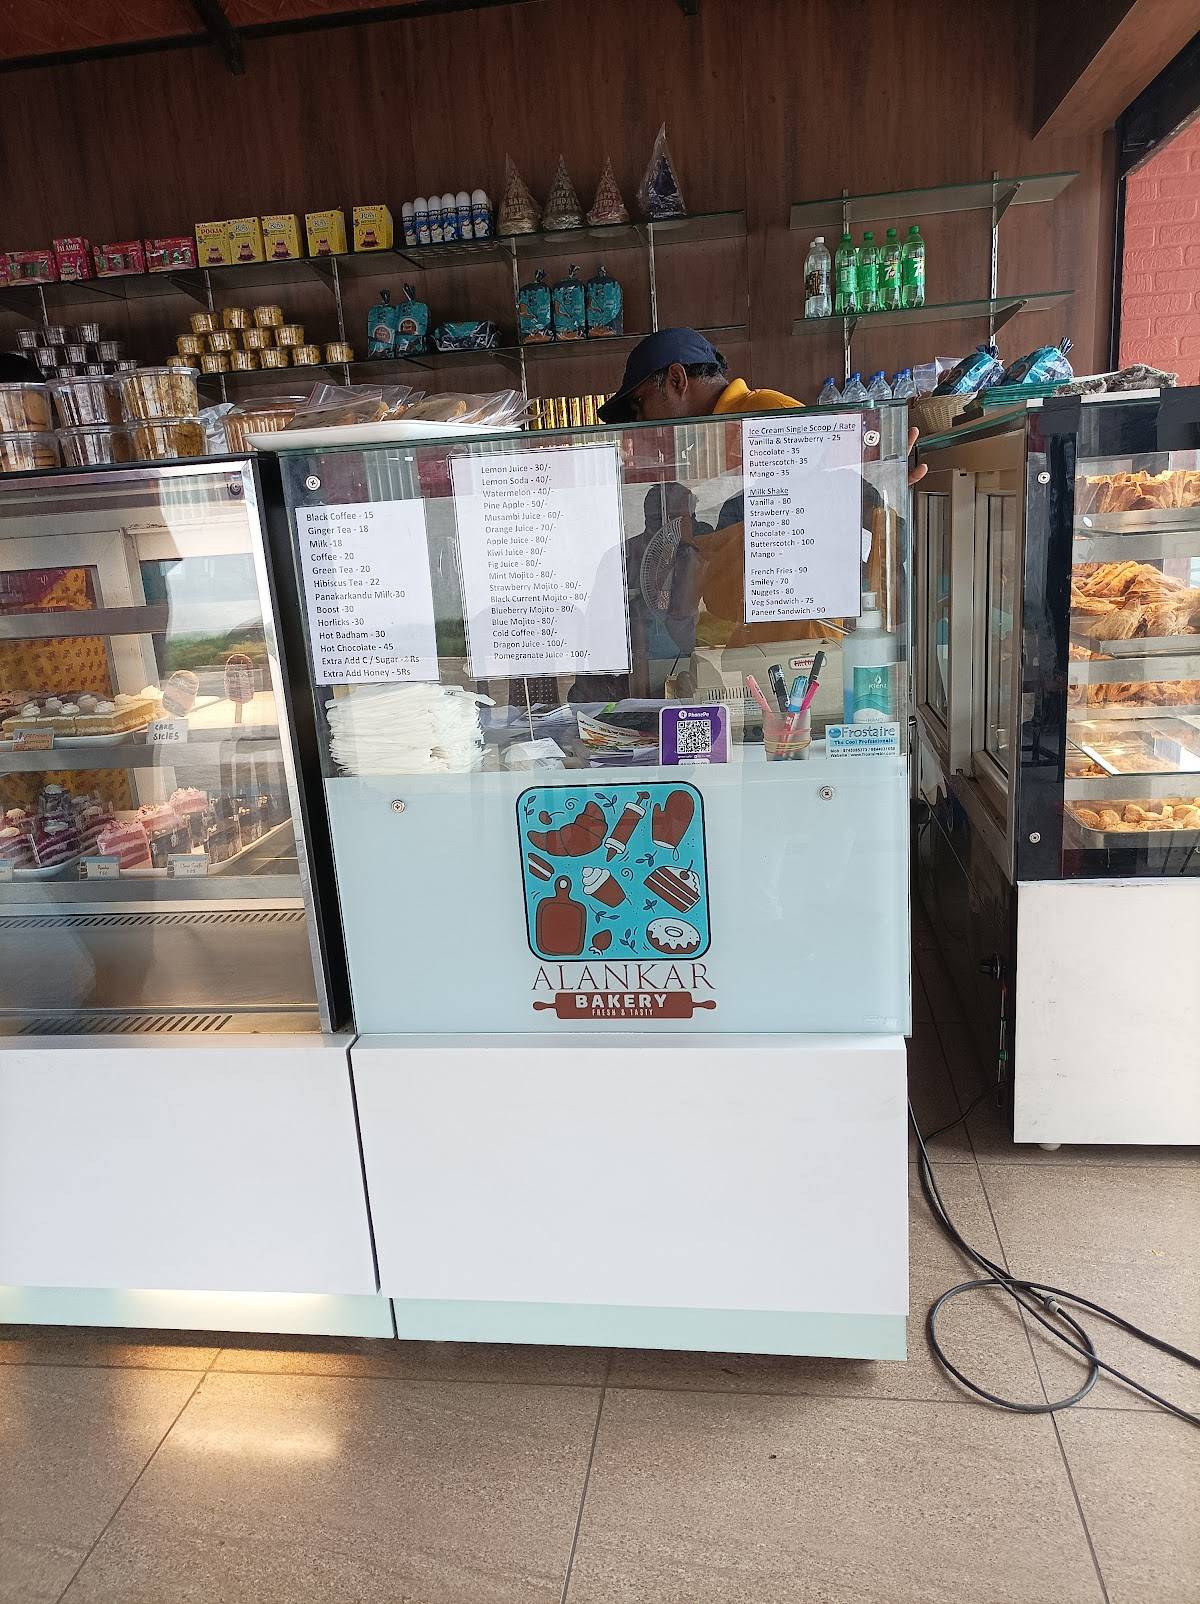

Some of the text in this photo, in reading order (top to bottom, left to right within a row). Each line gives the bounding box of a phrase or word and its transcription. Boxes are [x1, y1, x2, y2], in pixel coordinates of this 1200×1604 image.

[761, 427, 785, 435] Cream
[786, 425, 808, 434] Single
[809, 424, 831, 432] Scoop
[749, 438, 773, 446] Vanilla
[784, 435, 824, 444] Strawberry
[535, 463, 552, 472] 30/-
[482, 488, 554, 498] Watermelon 40/-
[502, 501, 524, 509] Apple
[330, 512, 356, 520] Coffee
[484, 513, 520, 522] Musambi
[308, 527, 334, 536] Ginger
[485, 526, 513, 534] Orange
[540, 523, 557, 531] 70/-
[309, 540, 328, 548] Milk
[486, 538, 508, 546] Apple
[536, 535, 552, 543] 80/-
[750, 540, 795, 548] Butterscotch
[487, 549, 503, 557] Kiwi
[530, 546, 546, 555] 80/-
[311, 553, 337, 561] Coffee
[488, 561, 499, 569] Fig
[526, 558, 542, 567] 80/-
[508, 572, 534, 580] Mojito
[540, 570, 556, 578] 80/-
[313, 580, 347, 588] Hibiscus
[490, 580, 581, 592] Strawberry Mojito 80/-
[751, 578, 774, 586] Smiley
[542, 593, 567, 602] Mojito
[574, 592, 590, 600] 80/-
[491, 606, 527, 616] Blueberry
[529, 605, 554, 614] Mojito
[510, 617, 535, 626] Mojito
[541, 616, 558, 624] 80/-
[319, 632, 334, 640] Hot
[541, 628, 558, 636] 80/-
[337, 644, 377, 652] Chocolate
[493, 641, 520, 649] Dragon
[547, 639, 567, 647] 100/-
[494, 652, 543, 660] Pomegranate
[571, 650, 591, 658] 100/-
[375, 656, 398, 665] Sugar
[363, 669, 389, 677] Honey
[842, 726, 895, 738] Frostaire
[531, 962, 716, 991] ALANKAR
[575, 994, 667, 1009] BAKERY
